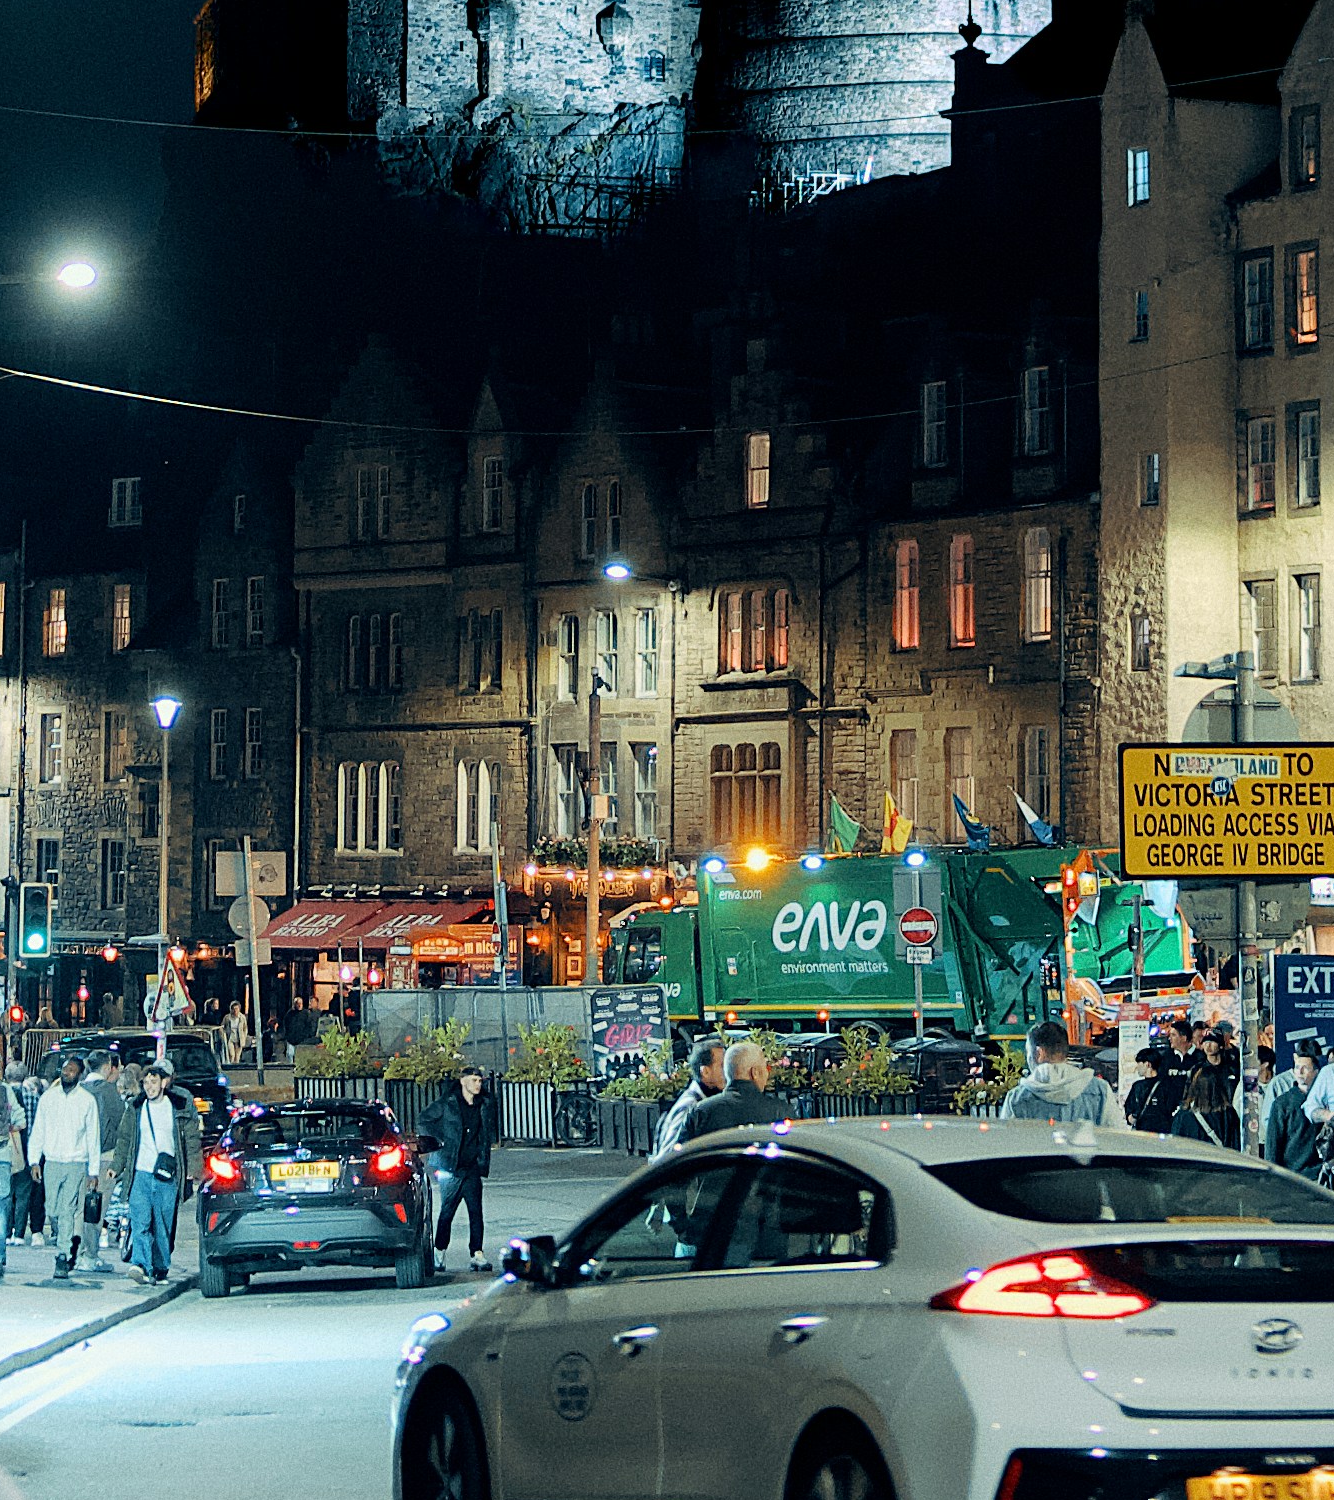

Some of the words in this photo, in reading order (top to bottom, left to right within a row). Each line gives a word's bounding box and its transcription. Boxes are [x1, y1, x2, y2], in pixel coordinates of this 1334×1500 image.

[1283, 753, 1314, 777] TO
[1134, 813, 1215, 837] LOADING
[1223, 813, 1299, 837] ACCESS
[1147, 843, 1224, 867] GEORGE
[1233, 843, 1249, 866] IV
[1257, 843, 1325, 866] BRIDGE
[719, 888, 762, 901] enva.com
[771, 899, 888, 953] enva
[781, 960, 847, 974] environment
[848, 960, 889, 973] matters
